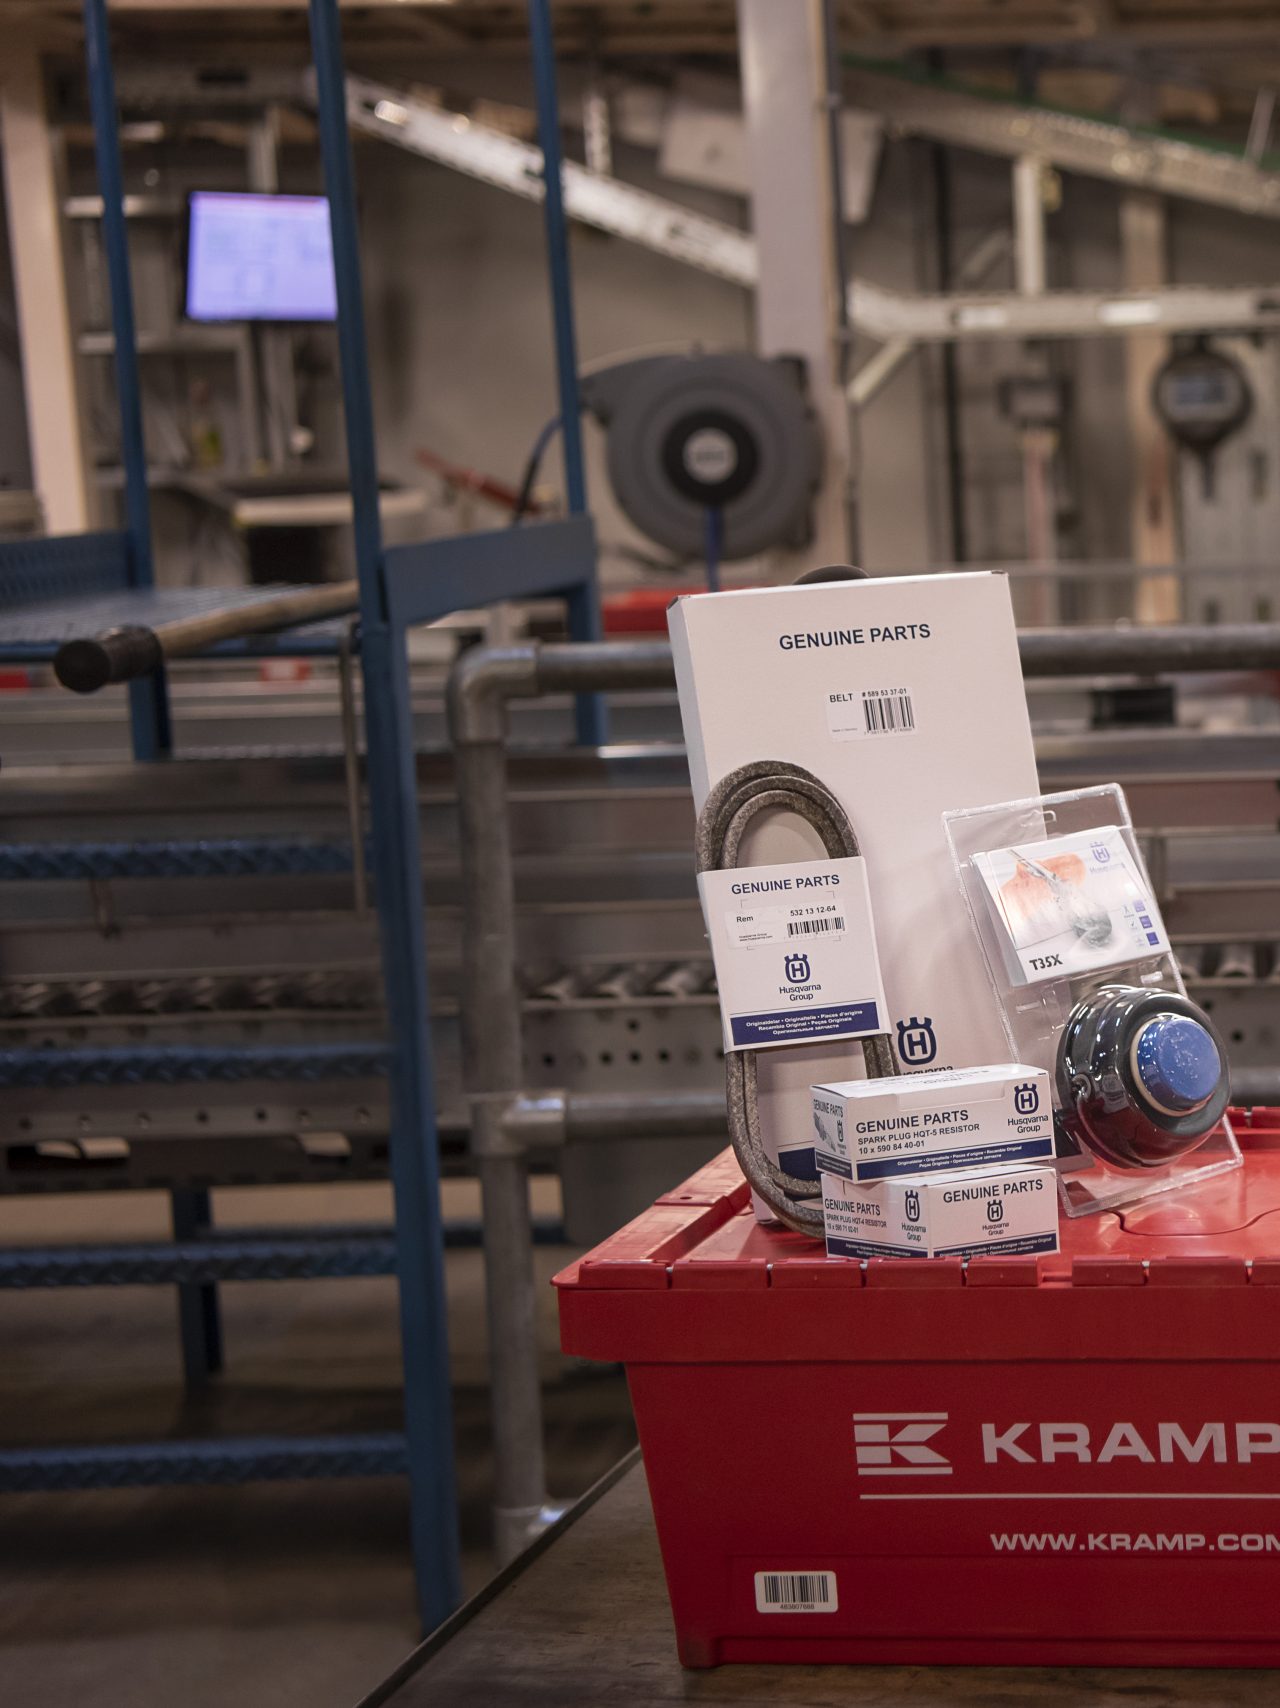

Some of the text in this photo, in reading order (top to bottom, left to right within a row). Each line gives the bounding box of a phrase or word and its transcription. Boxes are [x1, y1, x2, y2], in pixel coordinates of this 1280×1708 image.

[779, 623, 931, 650] GENUINE PARTS
[829, 693, 853, 703] BELT
[731, 874, 840, 895] GENUINE PARTS
[790, 909, 803, 917] 532
[1029, 954, 1063, 971] T35X
[779, 983, 822, 995] Husqvarna
[789, 992, 814, 1002] Group
[830, 1104, 844, 1118] PARTS
[856, 1109, 969, 1134] GENUINE PARTS
[1007, 1114, 1049, 1127] Husqvarna
[858, 1123, 980, 1145] SPARK PLUG HQT-5 RESISTOR
[1017, 1124, 1041, 1134] Group
[859, 1146, 869, 1155] 10
[877, 1144, 891, 1153] 590
[893, 1143, 903, 1151] 84
[904, 1140, 925, 1150] 40-01
[943, 1178, 1043, 1203] GENUINE PARTS
[825, 1198, 880, 1216] GENUINE PARTS
[826, 1213, 839, 1221] SPARK
[840, 1216, 851, 1224] PLUG
[865, 1219, 887, 1228] RESISTOR
[902, 1222, 927, 1232] Husqvarna
[982, 1221, 1010, 1231] Husqvarna
[907, 1232, 922, 1241] Group
[988, 1228, 1004, 1237] Group
